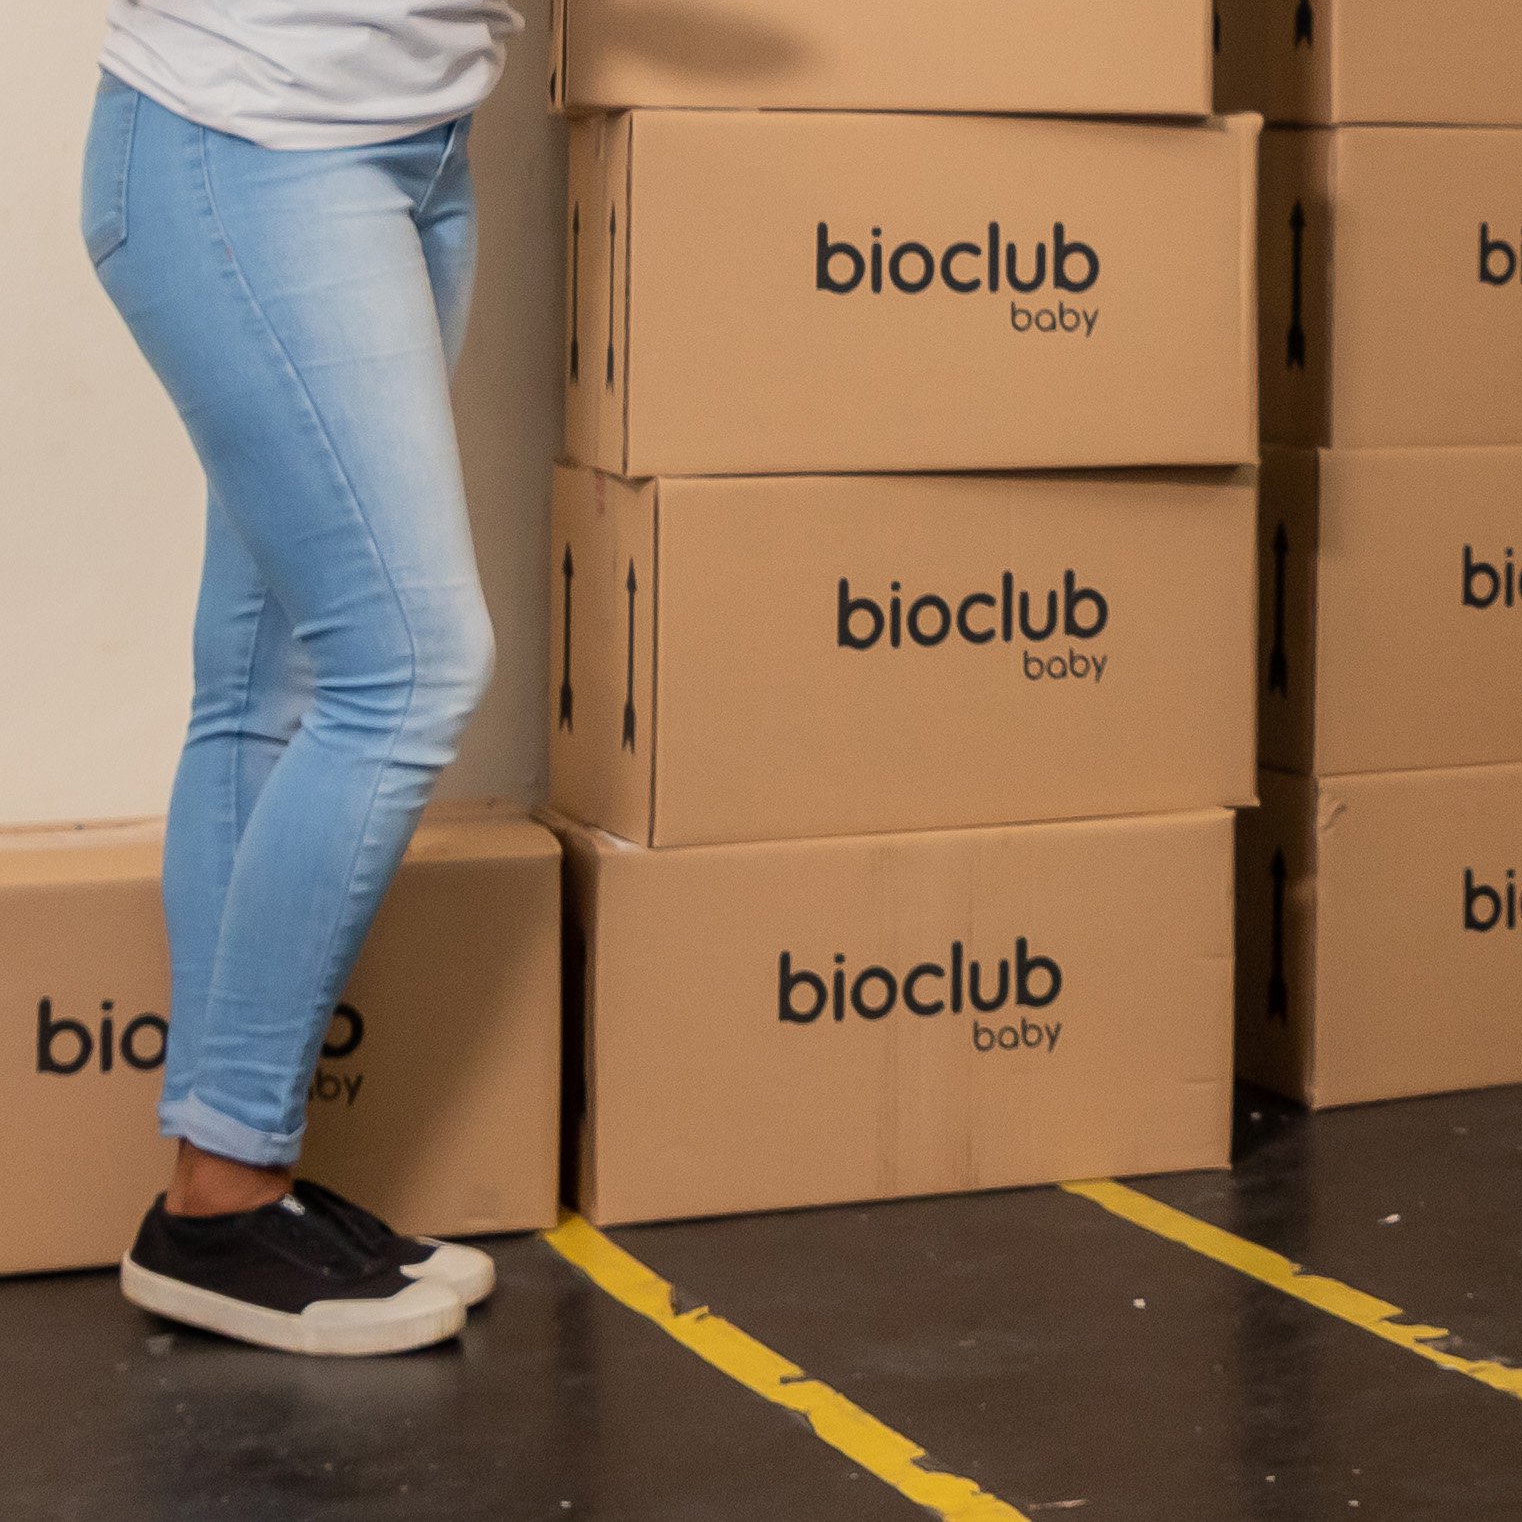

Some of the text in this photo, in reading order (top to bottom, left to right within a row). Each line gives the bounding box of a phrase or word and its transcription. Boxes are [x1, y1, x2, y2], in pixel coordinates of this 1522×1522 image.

[815, 221, 1100, 296] bioclub
[1010, 301, 1099, 337] baby
[836, 568, 1109, 652] bioclub
[1022, 648, 1108, 683] baby
[777, 936, 1063, 1026] bioclub
[972, 1017, 1062, 1053] baby
